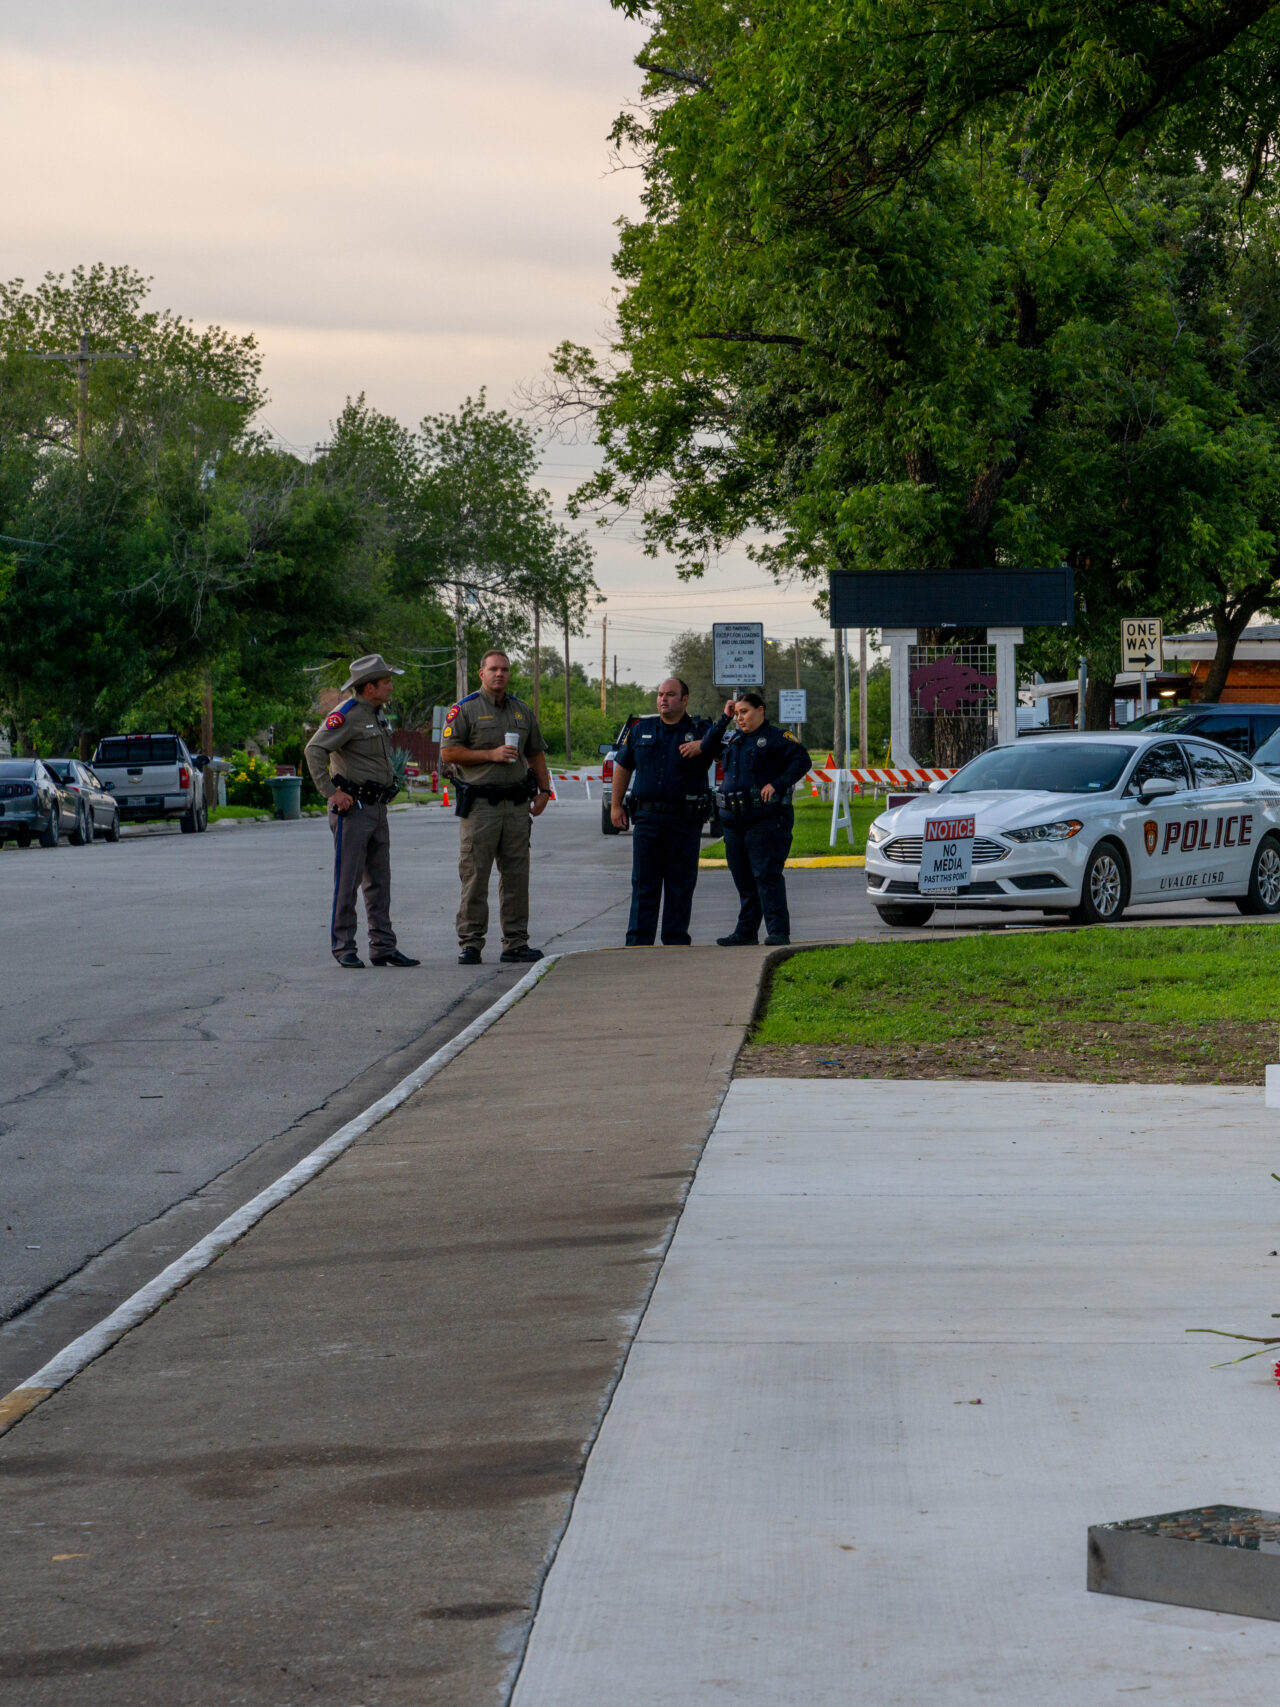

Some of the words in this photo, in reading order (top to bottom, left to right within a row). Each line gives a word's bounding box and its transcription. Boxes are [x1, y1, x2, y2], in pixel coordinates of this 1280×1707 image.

[1127, 623, 1157, 636] ONE
[1126, 637, 1157, 650] WAY
[927, 819, 974, 840] NOTICE
[1161, 814, 1254, 855] POLICE
[943, 843, 957, 857] NO
[933, 858, 962, 872] MEDIA
[924, 875, 939, 883] PAST
[940, 874, 952, 882] THIS
[952, 872, 967, 880] POINT
[1160, 873, 1199, 889] UVALDE
[1202, 871, 1225, 884] CISD
